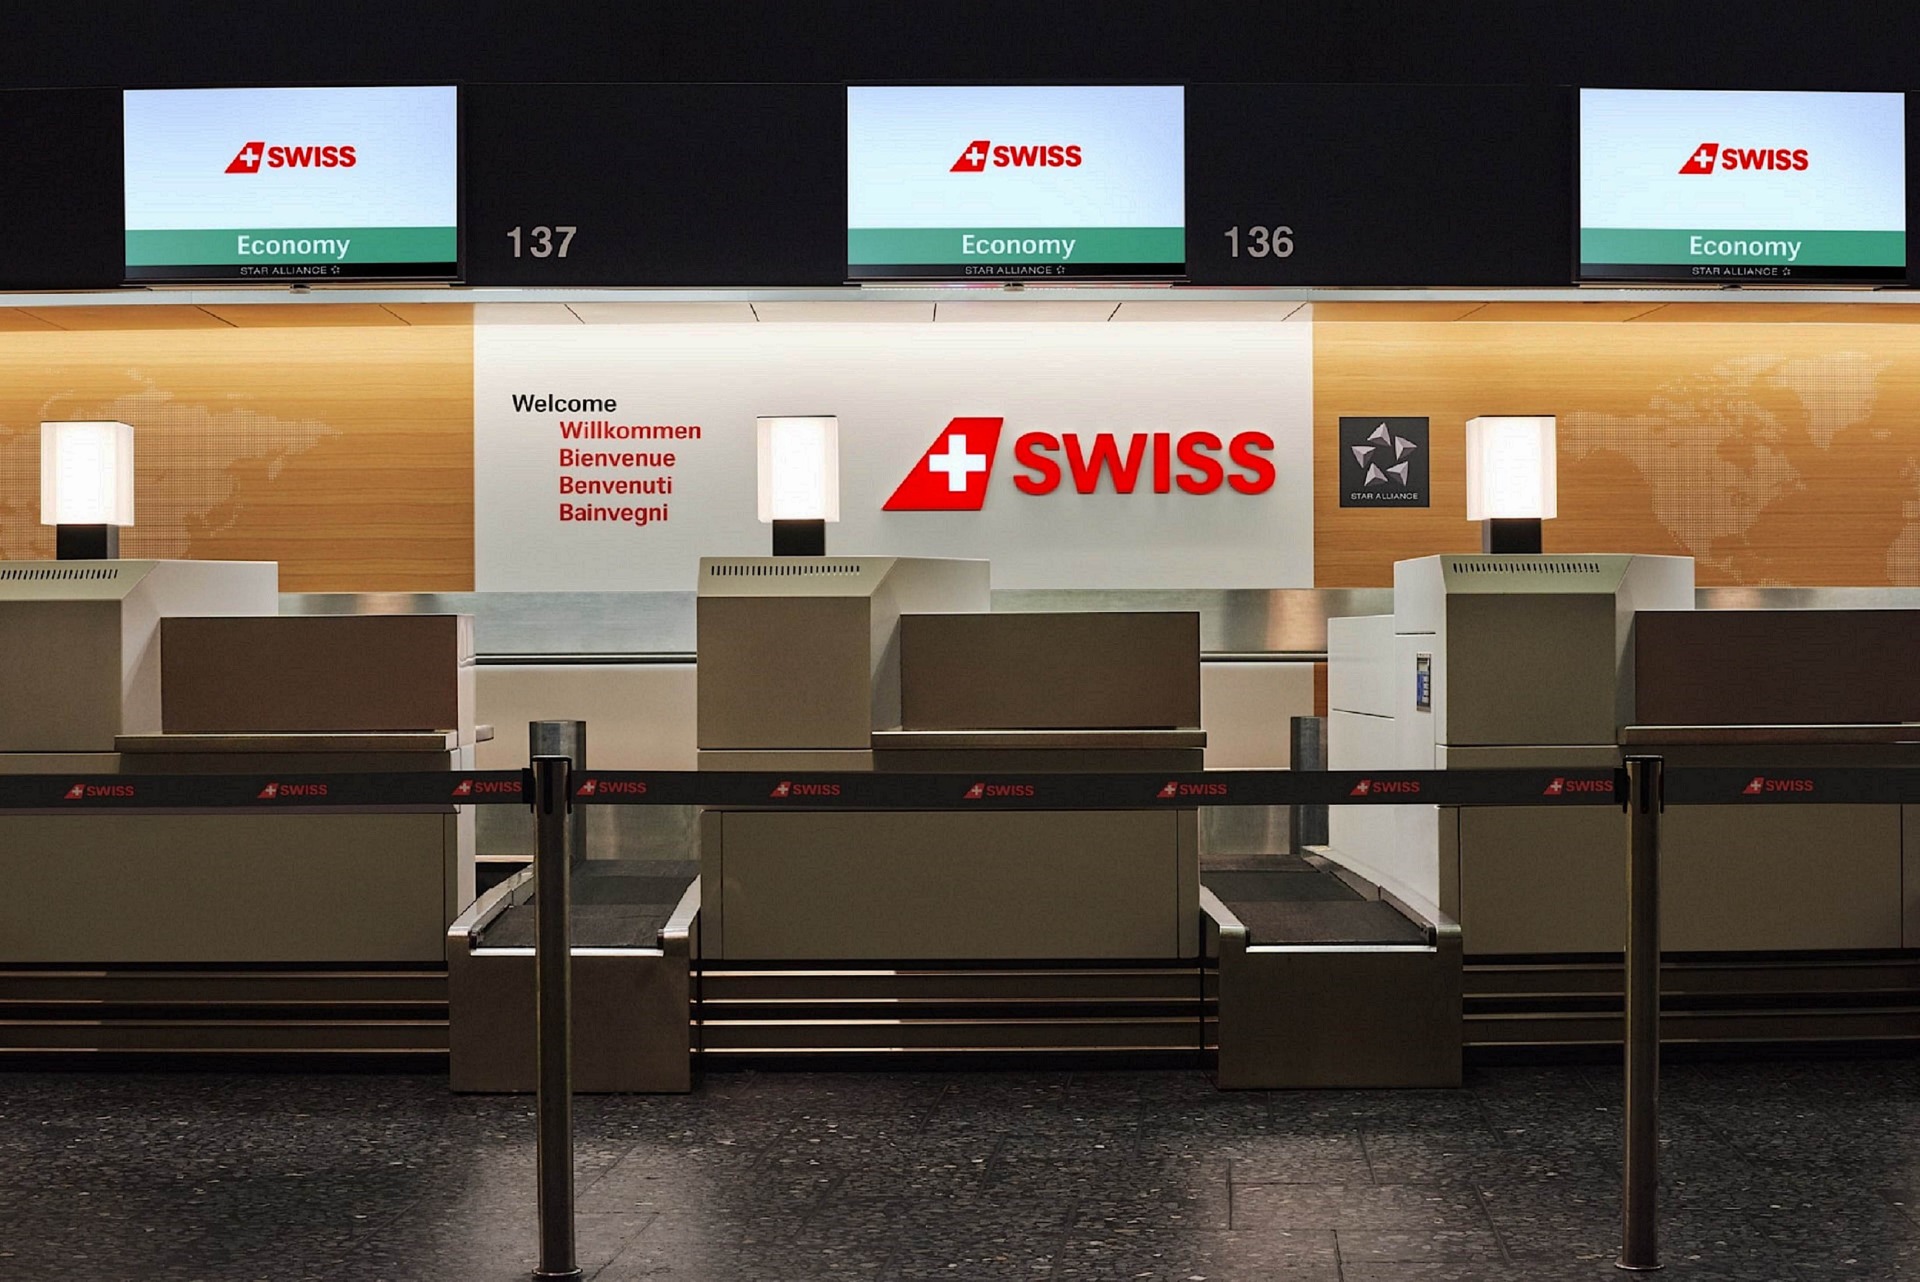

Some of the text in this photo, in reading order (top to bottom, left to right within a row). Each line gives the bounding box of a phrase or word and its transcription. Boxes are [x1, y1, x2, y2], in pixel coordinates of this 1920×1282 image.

[267, 145, 357, 168] SWISS
[992, 144, 1082, 167] SWISS
[1721, 148, 1809, 171] SWISS
[237, 234, 350, 259] Economy
[506, 226, 577, 258] 137
[962, 234, 1076, 259] Economy
[1224, 226, 1295, 258] 136
[1690, 235, 1802, 261] Economy
[240, 266, 327, 276] STAR ALLIANCE
[965, 265, 1052, 275] STAR ALLIANCE
[1692, 266, 1778, 276] STAR ALLIANCE
[512, 394, 617, 412] Welcome
[559, 420, 702, 440] Willkommen
[559, 448, 676, 467] Bienvenue
[1013, 431, 1276, 496] SWISS
[559, 475, 673, 495] Benvenuti
[1350, 492, 1419, 501] STAR ALLIANCE
[559, 503, 669, 526] Bainvegni
[86, 785, 135, 797] SWISS
[279, 784, 328, 796] SWISS
[474, 781, 523, 793] SWISS
[598, 781, 647, 793] SWISS
[792, 784, 840, 796] SWISS
[986, 785, 1034, 797] SWISS
[1179, 783, 1227, 795] SWISS
[1372, 781, 1420, 793] SWISS
[1566, 780, 1614, 792] SWISS
[1765, 779, 1814, 791] SWISS
